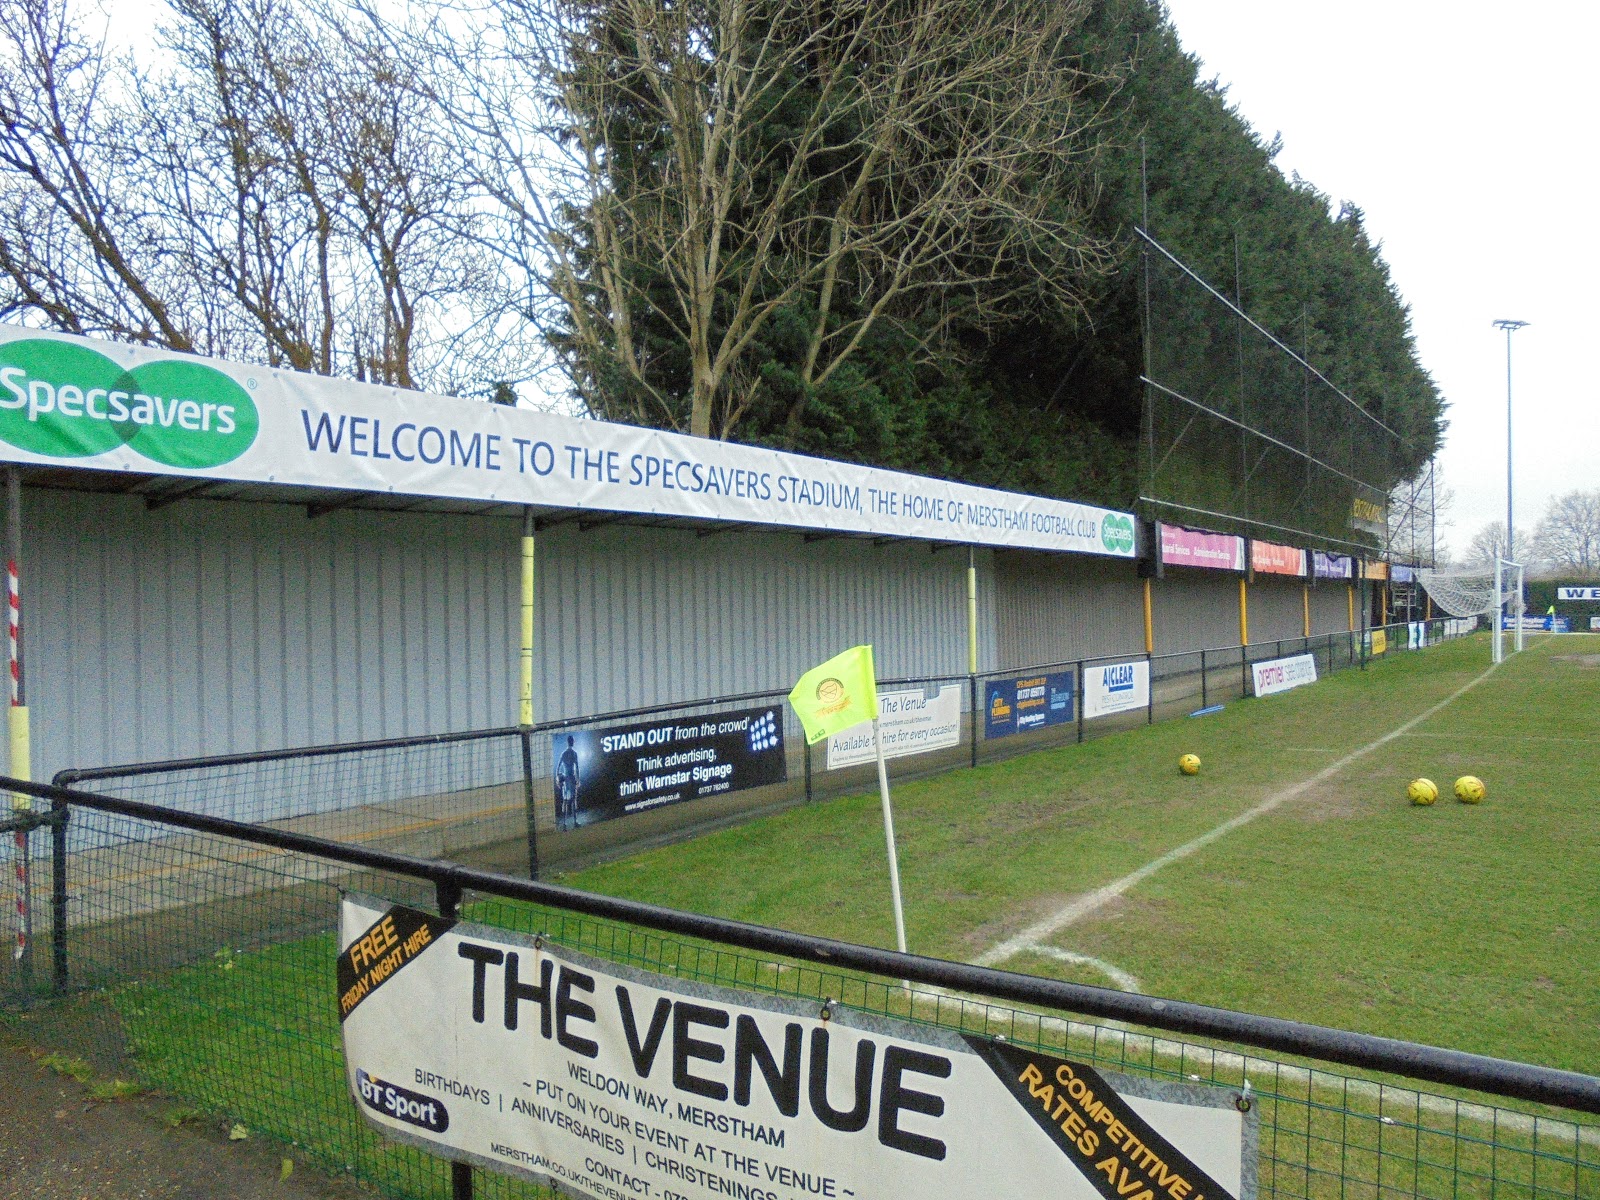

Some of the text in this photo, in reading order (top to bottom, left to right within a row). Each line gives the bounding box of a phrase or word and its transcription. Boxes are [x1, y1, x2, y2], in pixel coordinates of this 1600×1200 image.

[0, 366, 236, 434] Specsavers
[301, 409, 1096, 538] WELCOME TO THE SPECSAVERS STADIUM, THE HOME OF MERSTHAM FOOTBALL CLUB
[647, 726, 673, 745] OUT
[674, 723, 699, 741] from
[700, 720, 717, 737] the
[831, 735, 869, 752] Available
[882, 731, 896, 744] hire
[898, 729, 909, 742] for
[909, 728, 929, 744] every
[929, 722, 957, 737] occasion!
[881, 697, 927, 713] The Venue
[620, 763, 733, 796] think Warnstar Signage
[636, 747, 717, 772] Think advertising,
[341, 923, 432, 1013] FRIDAY NIGHT HIRE
[350, 915, 399, 974] FREE
[458, 942, 952, 1161] THE VENUE
[361, 1078, 437, 1125] BT Sport
[415, 1068, 490, 1105] BIRTHDAYS
[511, 1097, 624, 1155] ANNIVERSARIES
[567, 1060, 629, 1100] WELDON
[678, 1102, 785, 1148] MERSTHAM
[1017, 1062, 1100, 1156] RATES
[1055, 1064, 1193, 1200] COMPETITIVE
[536, 1080, 836, 1198] PUT ON YOUR EVENT AT THE VENUE
[586, 1157, 650, 1196] CONTACT
